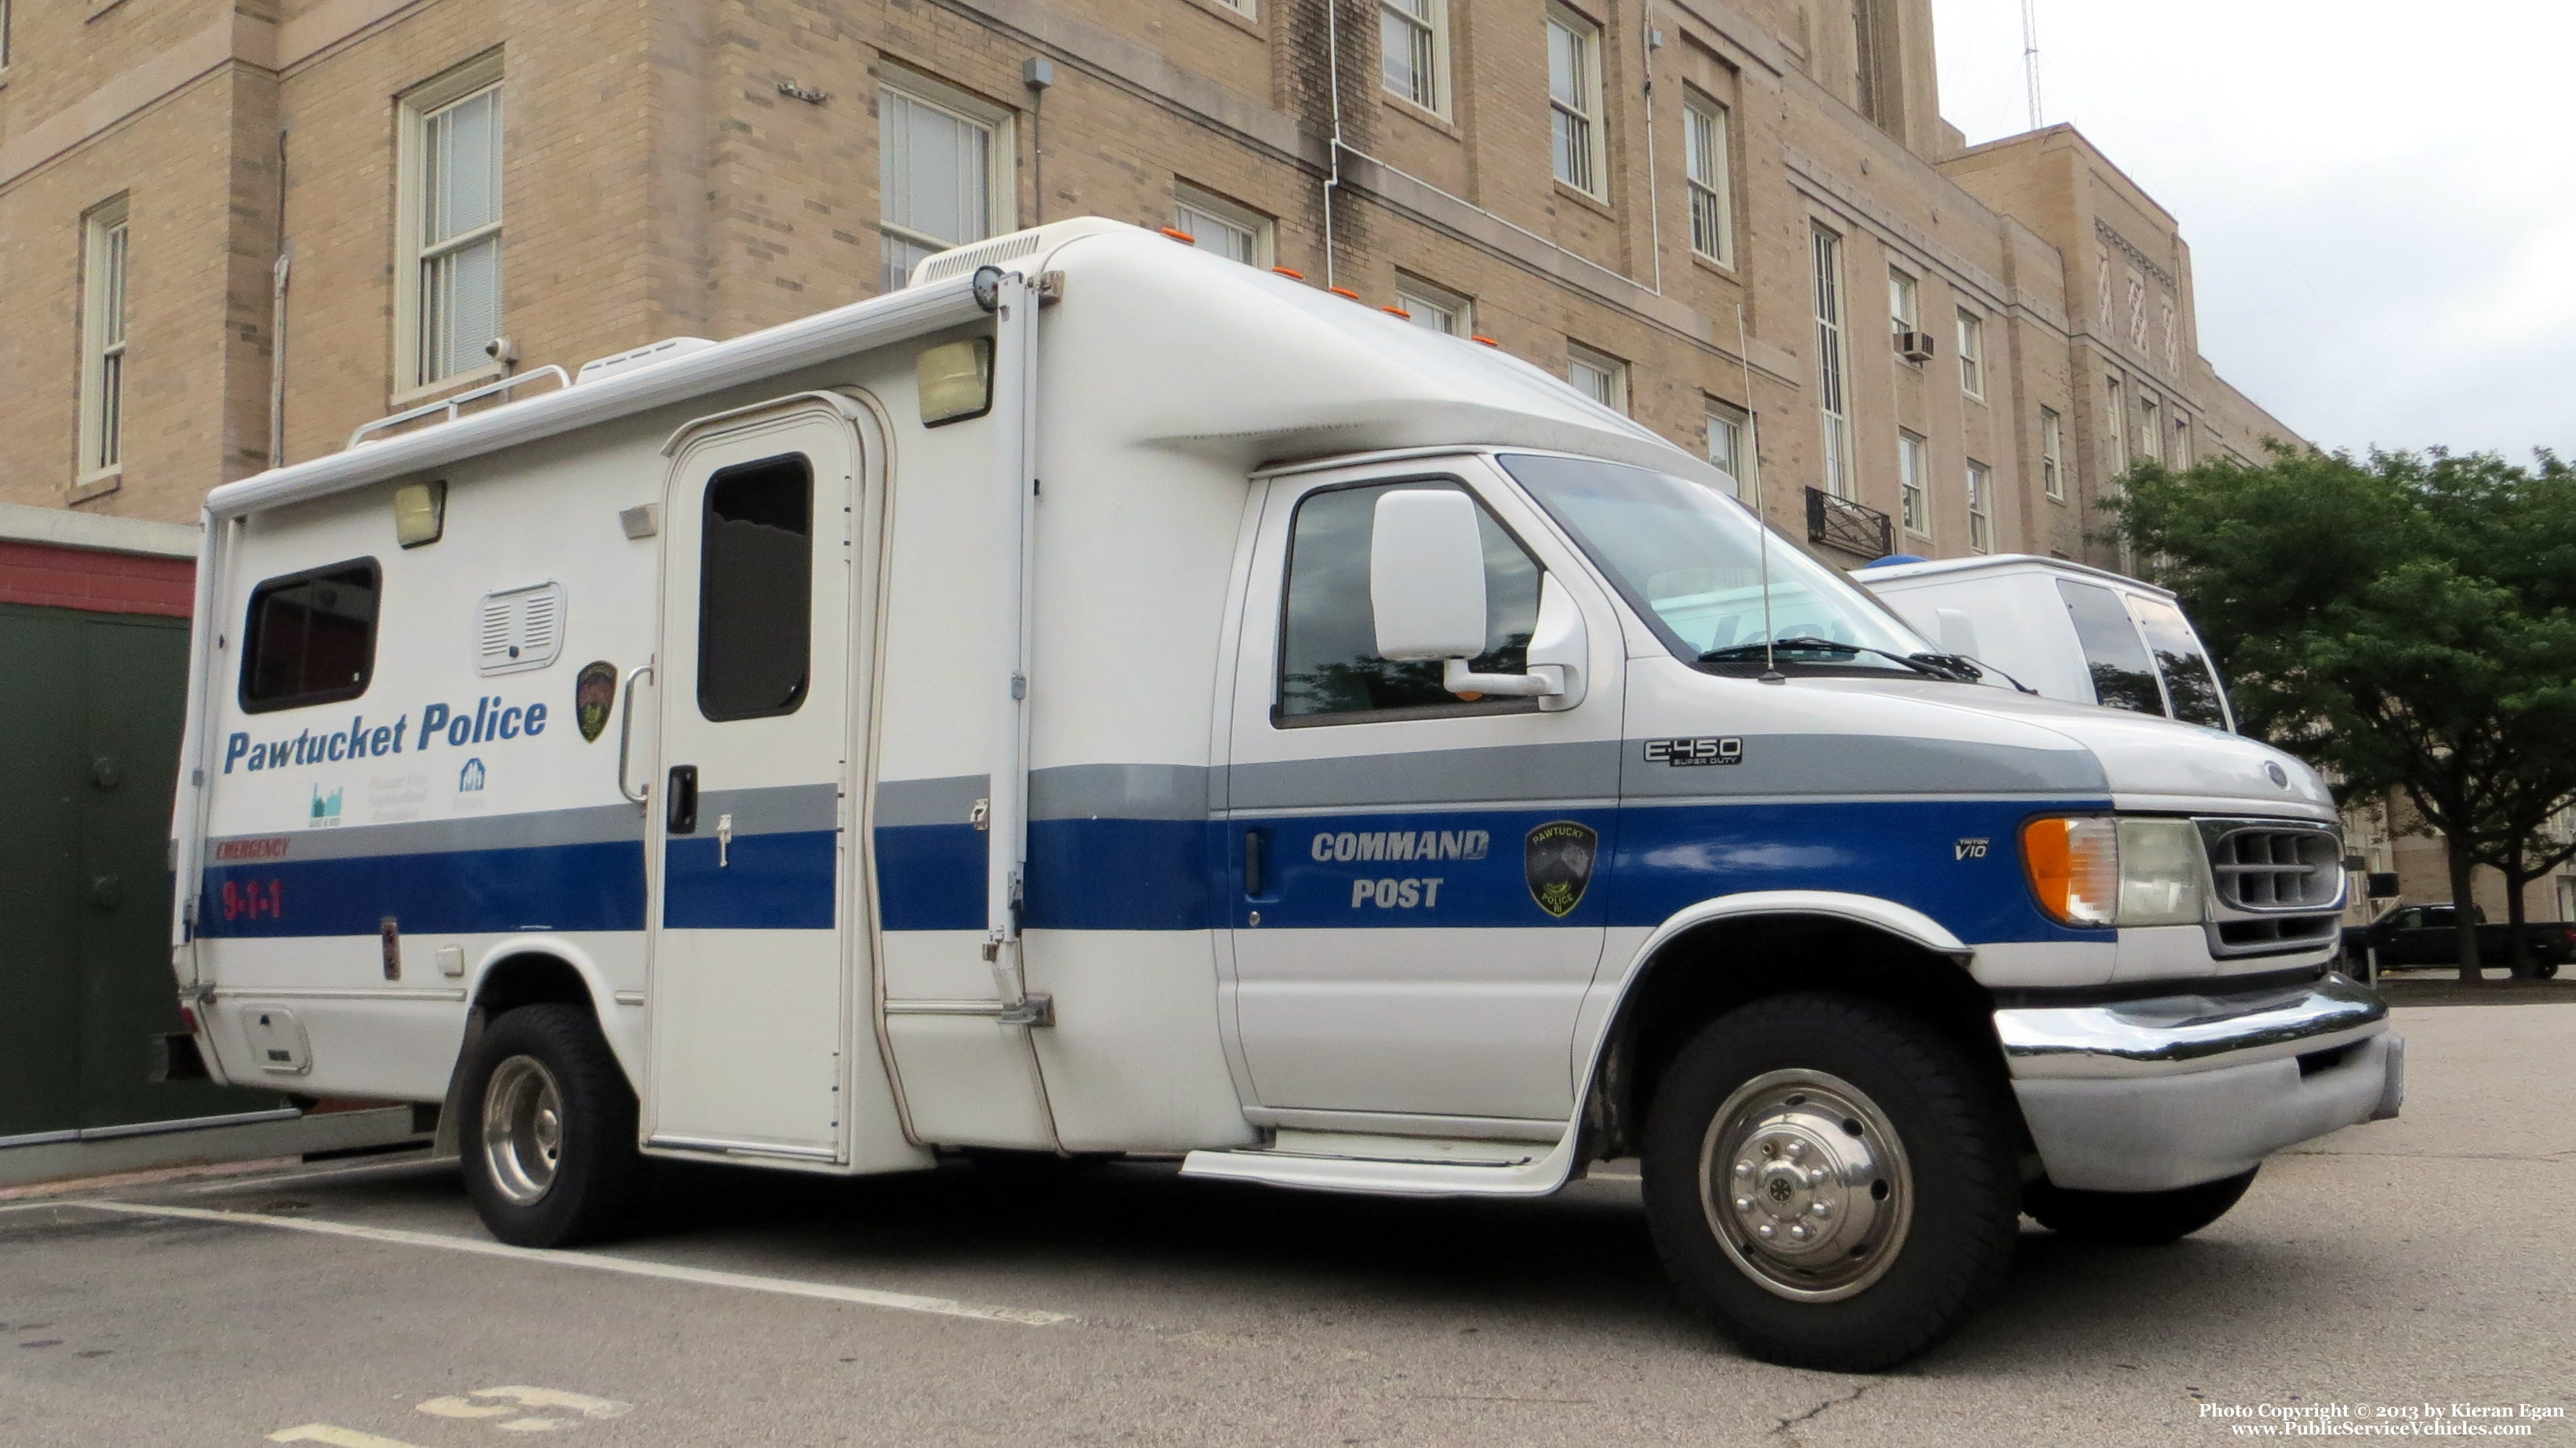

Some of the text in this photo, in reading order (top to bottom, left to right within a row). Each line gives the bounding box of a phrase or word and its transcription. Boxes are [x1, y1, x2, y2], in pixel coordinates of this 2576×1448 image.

[223, 695, 548, 774] Pawtucket Police
[215, 836, 291, 860] EMERGENCY
[1311, 829, 1490, 862] COMMAND
[1954, 844, 1987, 861] V10
[1351, 878, 1445, 909] POST
[1541, 892, 1574, 904] POLICE
